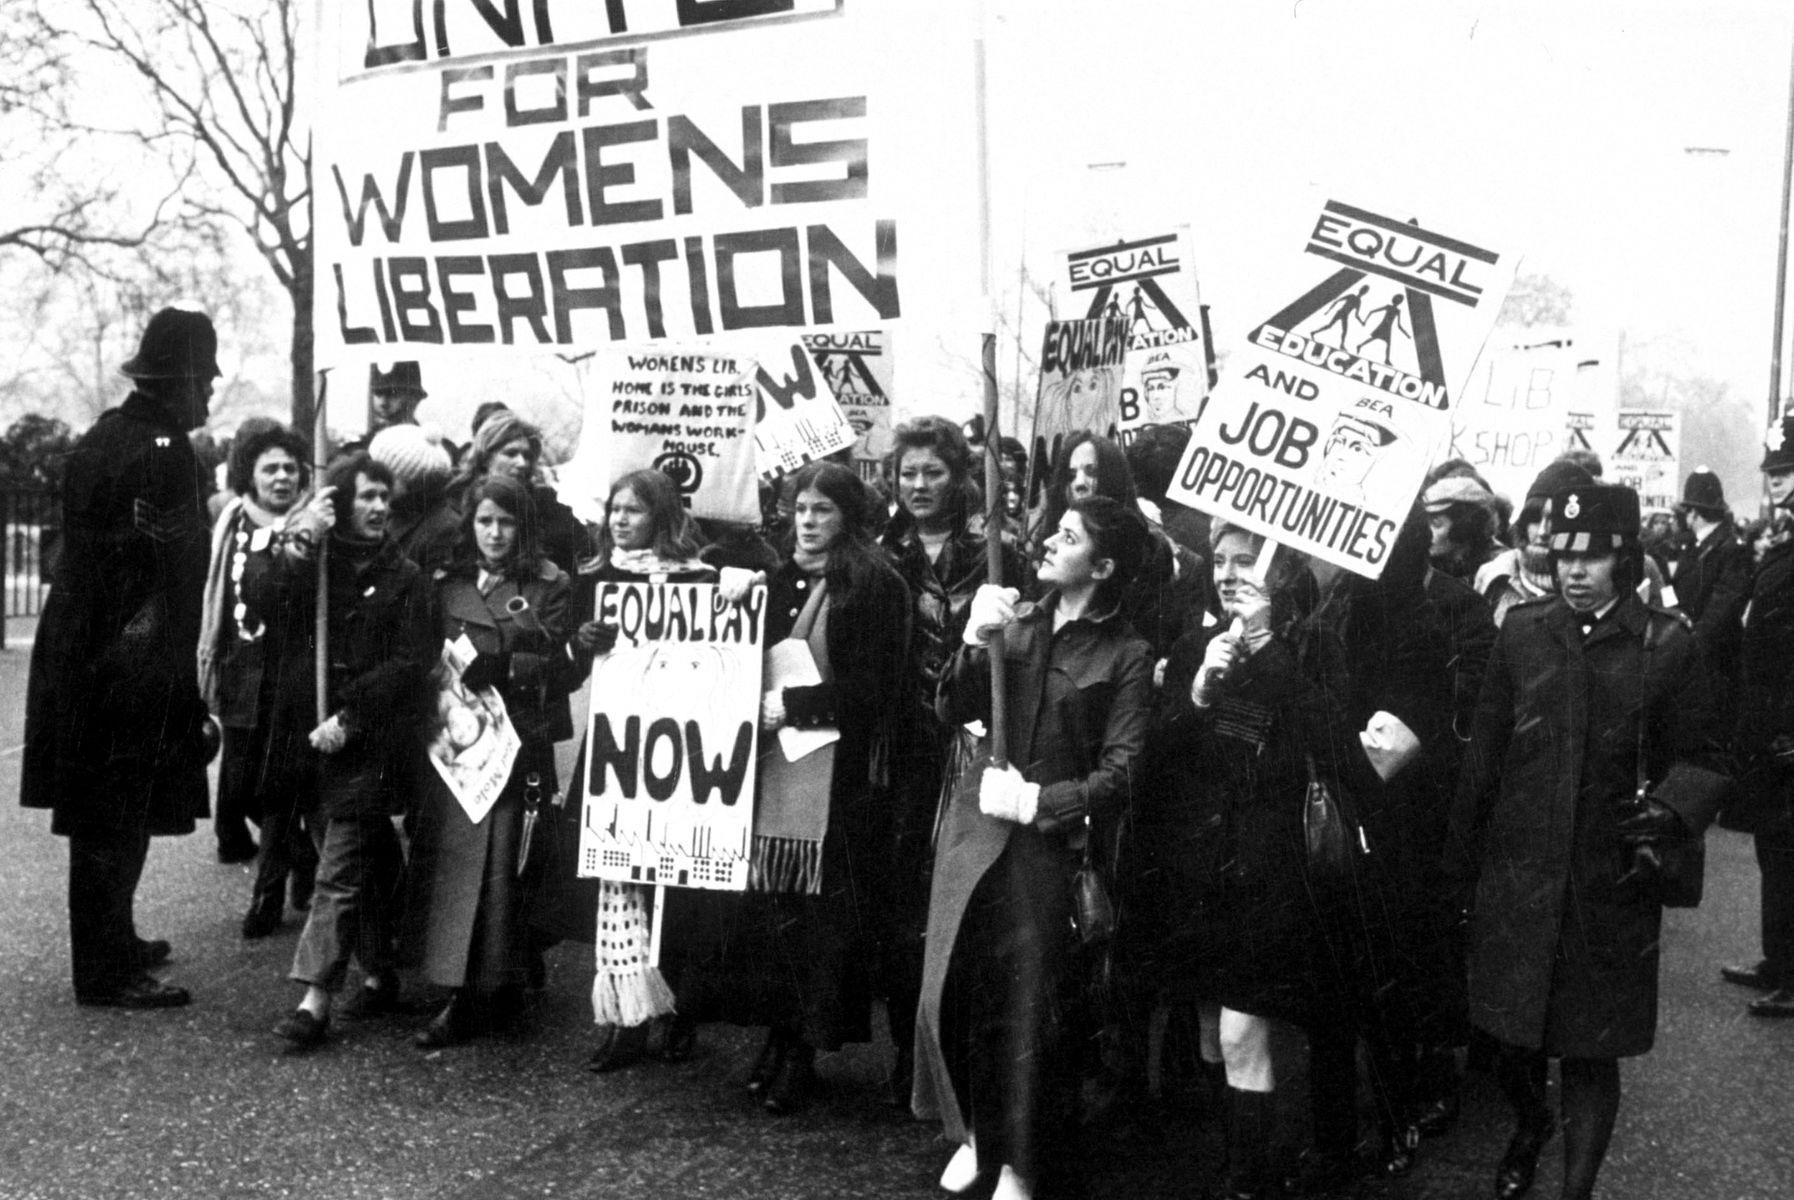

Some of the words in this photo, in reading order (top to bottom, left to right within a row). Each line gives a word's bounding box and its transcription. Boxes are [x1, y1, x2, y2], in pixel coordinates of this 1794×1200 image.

[437, 47, 654, 132] FOR
[331, 96, 869, 246] WOMENS
[1069, 247, 1180, 283] EQUAL
[1311, 214, 1483, 295] EQUAL
[333, 219, 900, 345] LIBERATION
[1129, 327, 1193, 349] ATION
[612, 381, 652, 395] HOME
[661, 382, 675, 396] IS
[681, 383, 711, 396] THE
[628, 355, 705, 373] WOMENS
[713, 359, 741, 375] LIB.
[1244, 364, 1320, 401] AND
[1256, 325, 1447, 409] EDUCATION
[611, 419, 681, 436] WOMANS
[686, 425, 745, 439] WORK-
[612, 400, 671, 415] PRISON
[679, 404, 713, 418] AND
[716, 404, 747, 417] THE
[1356, 398, 1394, 418] BEA
[662, 439, 720, 457] HOUSE.
[1219, 402, 1319, 469] JOB
[1448, 421, 1553, 468] KSHOP
[1180, 446, 1397, 565] OPPORTUNITIES
[601, 583, 705, 648] EQUAL
[589, 713, 753, 806] NOW
